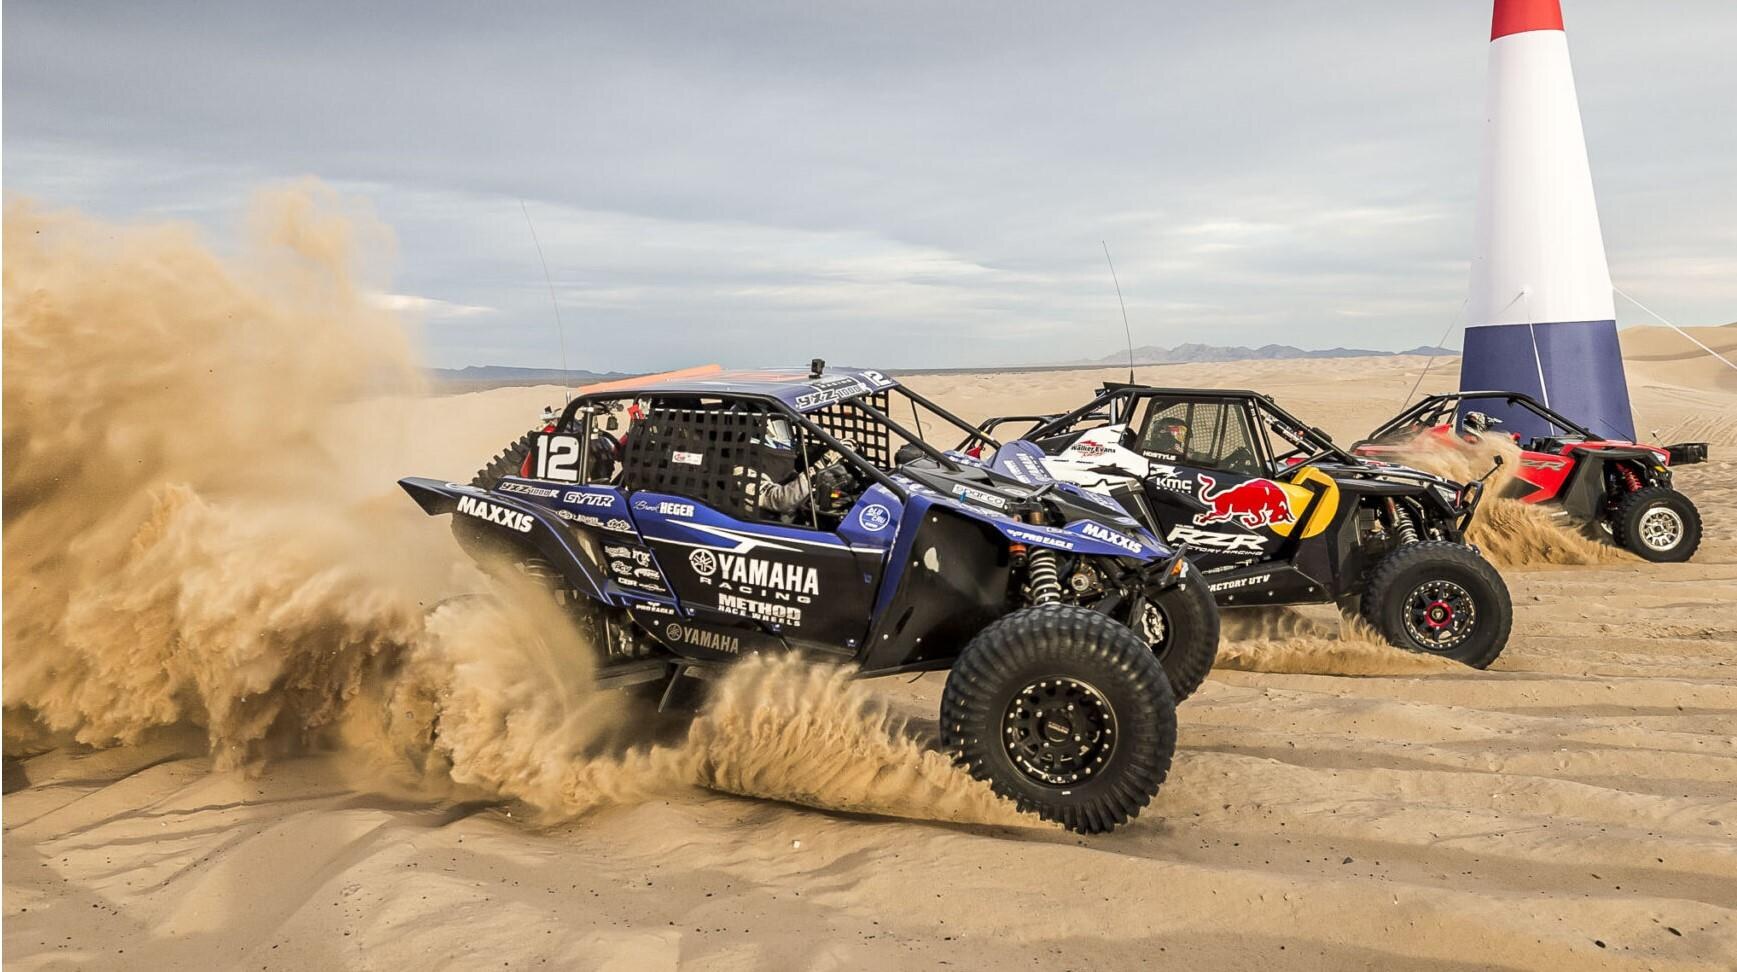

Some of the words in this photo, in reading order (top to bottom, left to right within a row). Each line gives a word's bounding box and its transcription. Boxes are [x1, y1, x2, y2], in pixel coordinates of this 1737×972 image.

[537, 435, 579, 481] 12
[1072, 444, 1094, 452] Walker
[1156, 477, 1192, 490] KMC
[563, 491, 615, 507] GYTR
[660, 502, 694, 517] HEGER
[457, 496, 534, 533] MAXXIS
[1042, 538, 1074, 550] EAGLE
[1082, 523, 1143, 553] MAXXIS
[1167, 526, 1269, 550] RZR
[718, 553, 819, 595] YAMAHA
[1208, 578, 1248, 592] ACTORY
[1248, 574, 1270, 585] UTV
[700, 576, 811, 604] RACING
[718, 593, 801, 620] METHOD
[718, 605, 747, 617] RACE
[752, 612, 801, 627] WHEELS
[683, 626, 739, 654] YAMAHA
